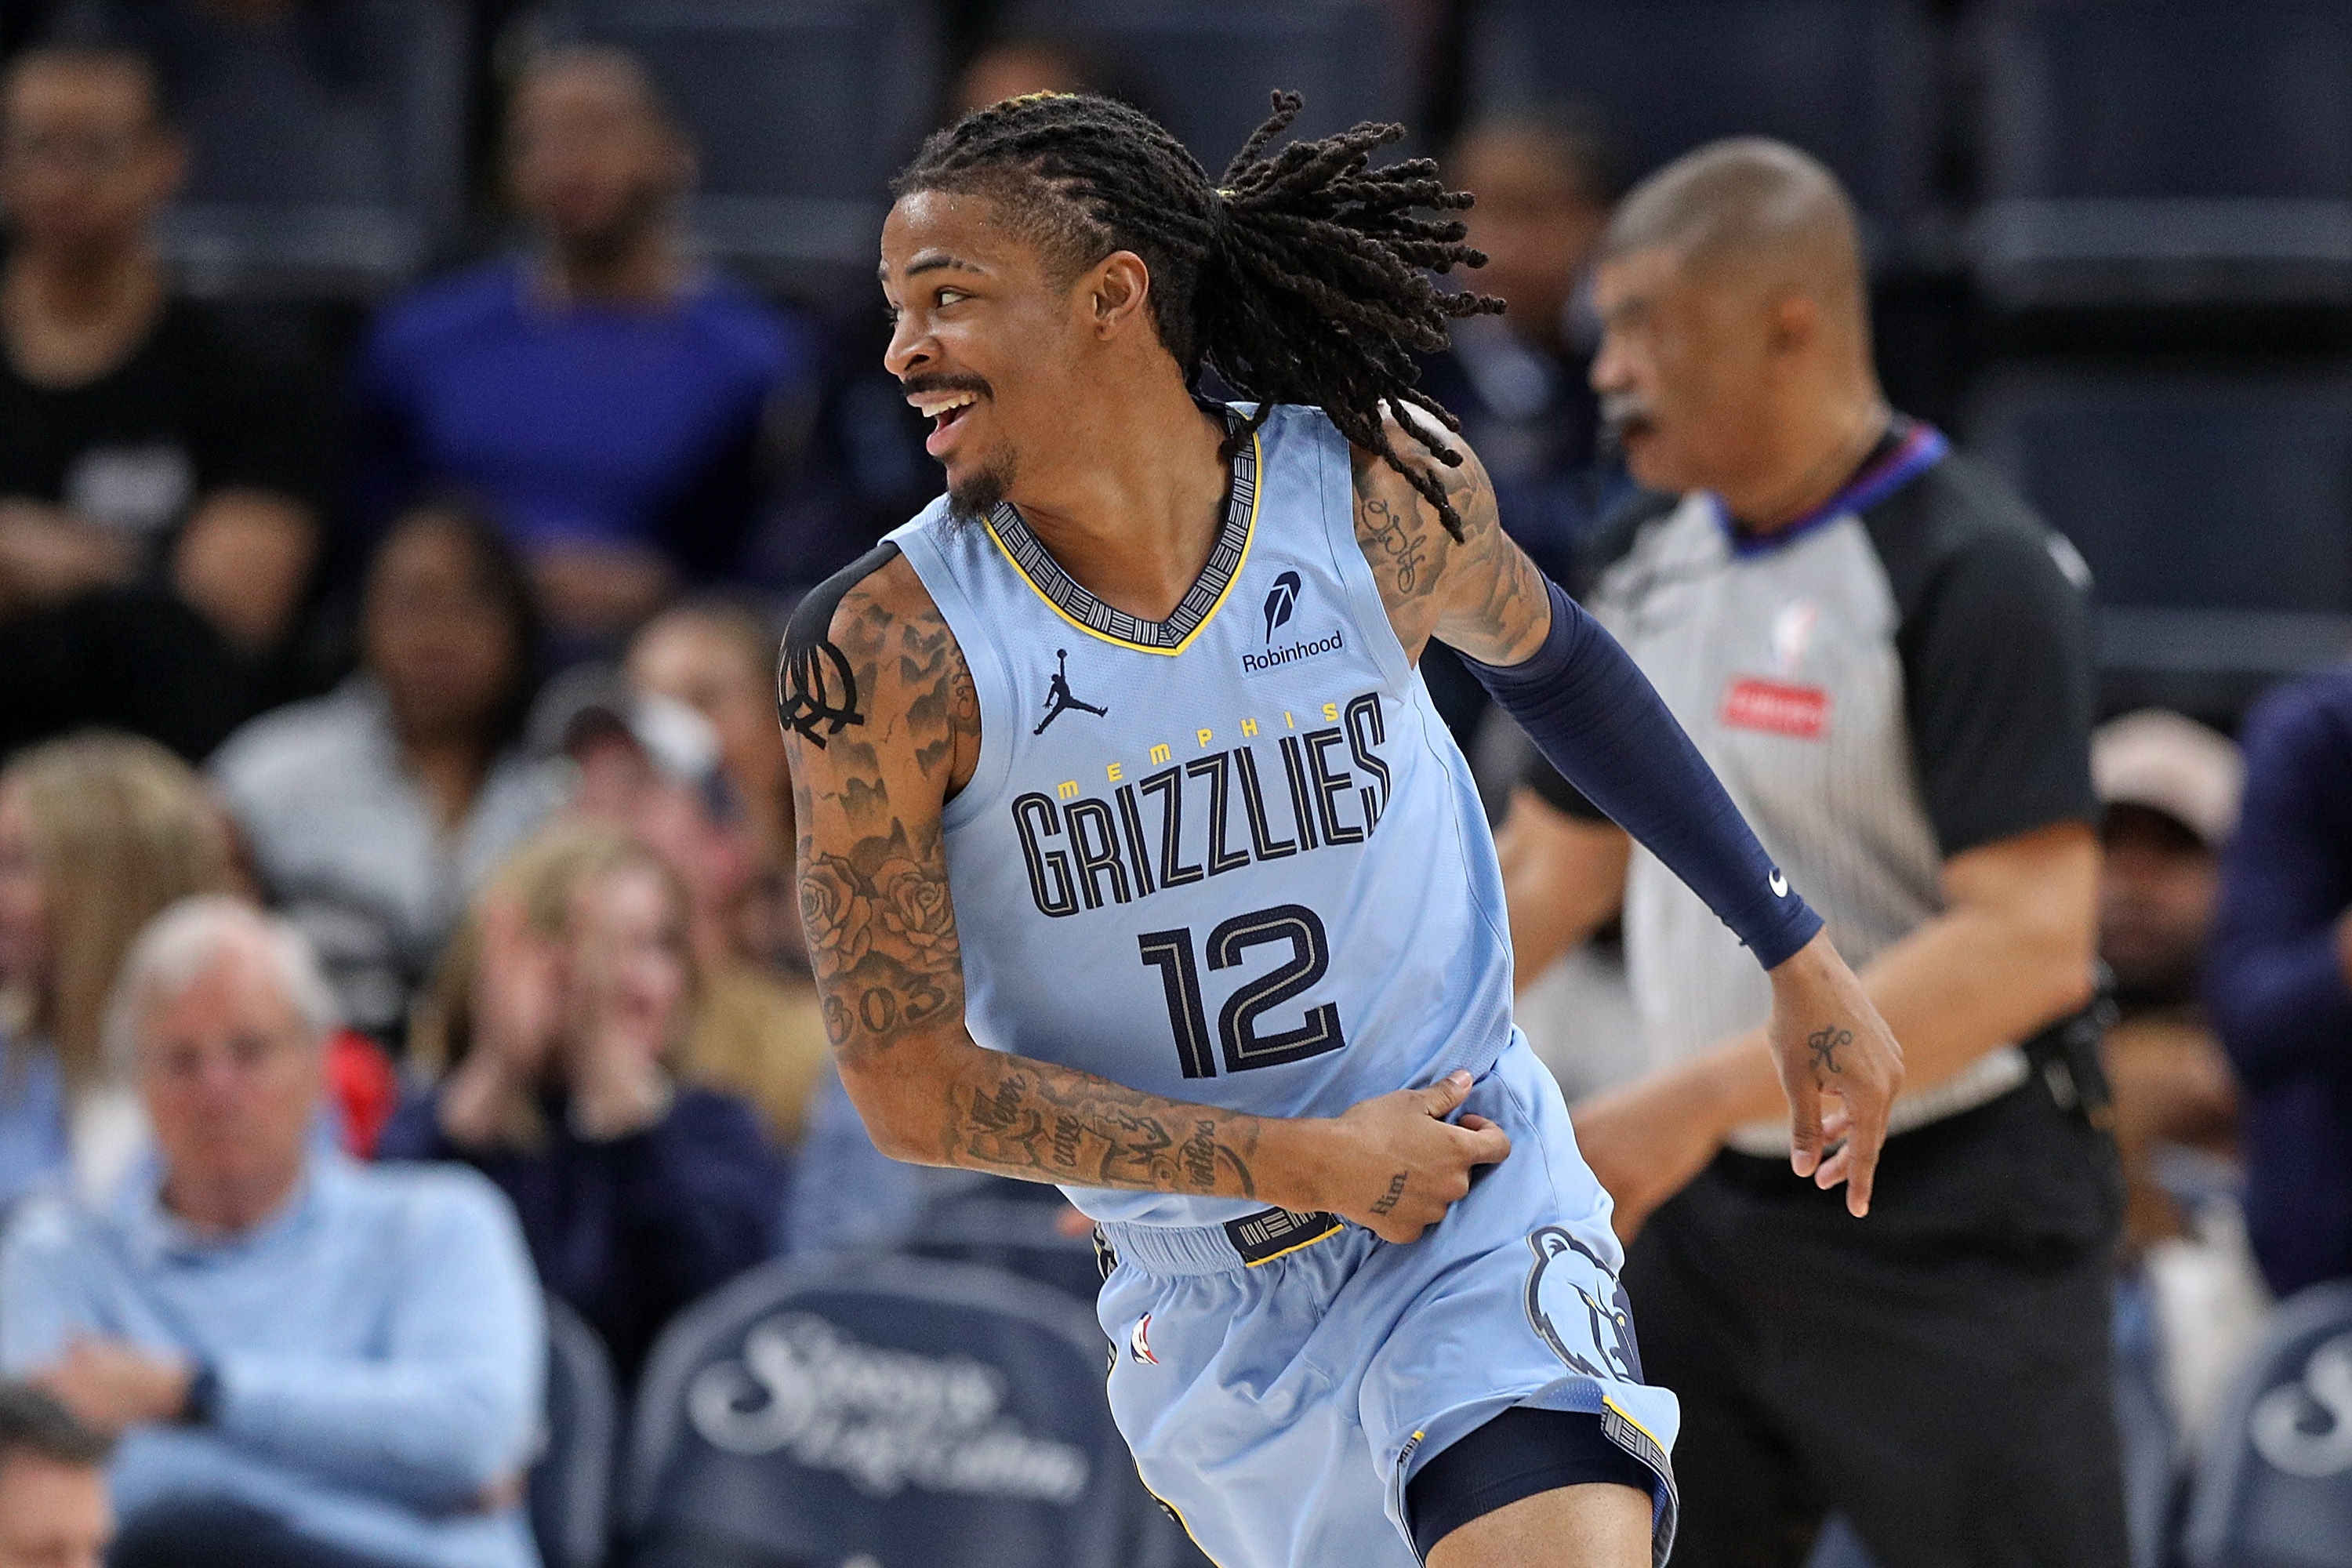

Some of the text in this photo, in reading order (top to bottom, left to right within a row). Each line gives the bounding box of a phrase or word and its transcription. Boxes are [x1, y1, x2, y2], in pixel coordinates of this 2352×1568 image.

[1242, 630, 1344, 673] Robinhood
[1011, 692, 1391, 917] GRIZZLIES
[1137, 903, 1346, 1079] 12
